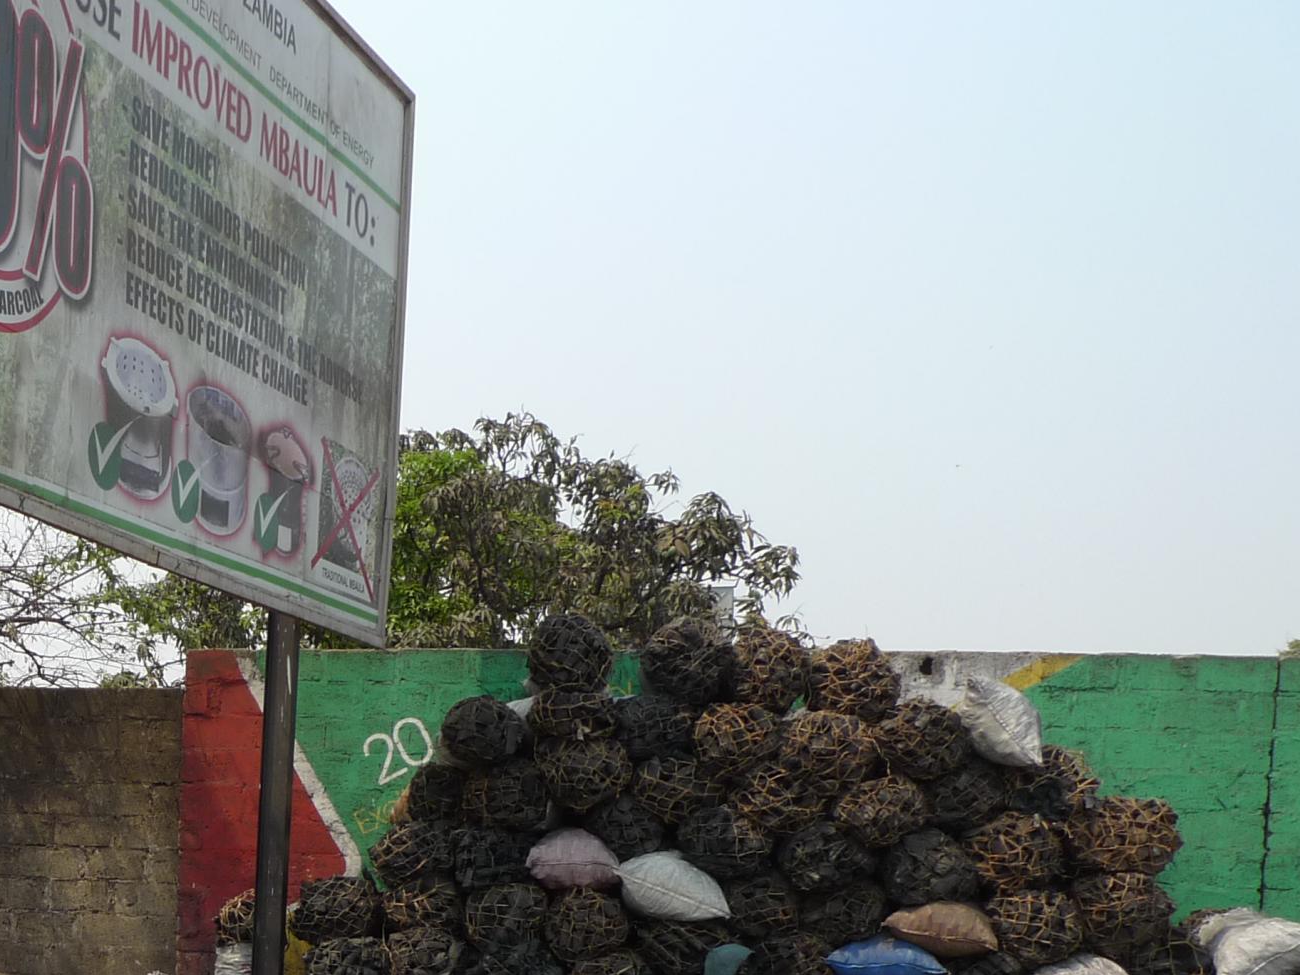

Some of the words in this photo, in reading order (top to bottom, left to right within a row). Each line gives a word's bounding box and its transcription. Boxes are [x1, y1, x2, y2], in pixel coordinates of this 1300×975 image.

[131, 1, 252, 143] IMPROVED
[260, 111, 338, 217] MBAULA
[345, 181, 378, 247] TO:
[131, 95, 170, 153] SAVE
[172, 125, 220, 190] MONEY
[269, 65, 329, 126] DEPARTMENT
[329, 119, 341, 139] OF
[343, 131, 375, 169] ENERGY
[127, 183, 166, 239] SAVE
[168, 210, 196, 255] THE
[198, 228, 287, 315] ENVIRONMENT
[129, 139, 188, 210] REDUCE
[190, 182, 241, 246] INDOOR
[244, 220, 306, 292] POLLUTION
[126, 227, 184, 294] REDUCE
[186, 265, 285, 356] DEFORESTATION
[126, 271, 184, 335] EFFECTS
[187, 308, 205, 345] OF
[206, 320, 260, 379] CLIMATE
[261, 353, 308, 406] CHANGE
[363, 717, 434, 786] 20
